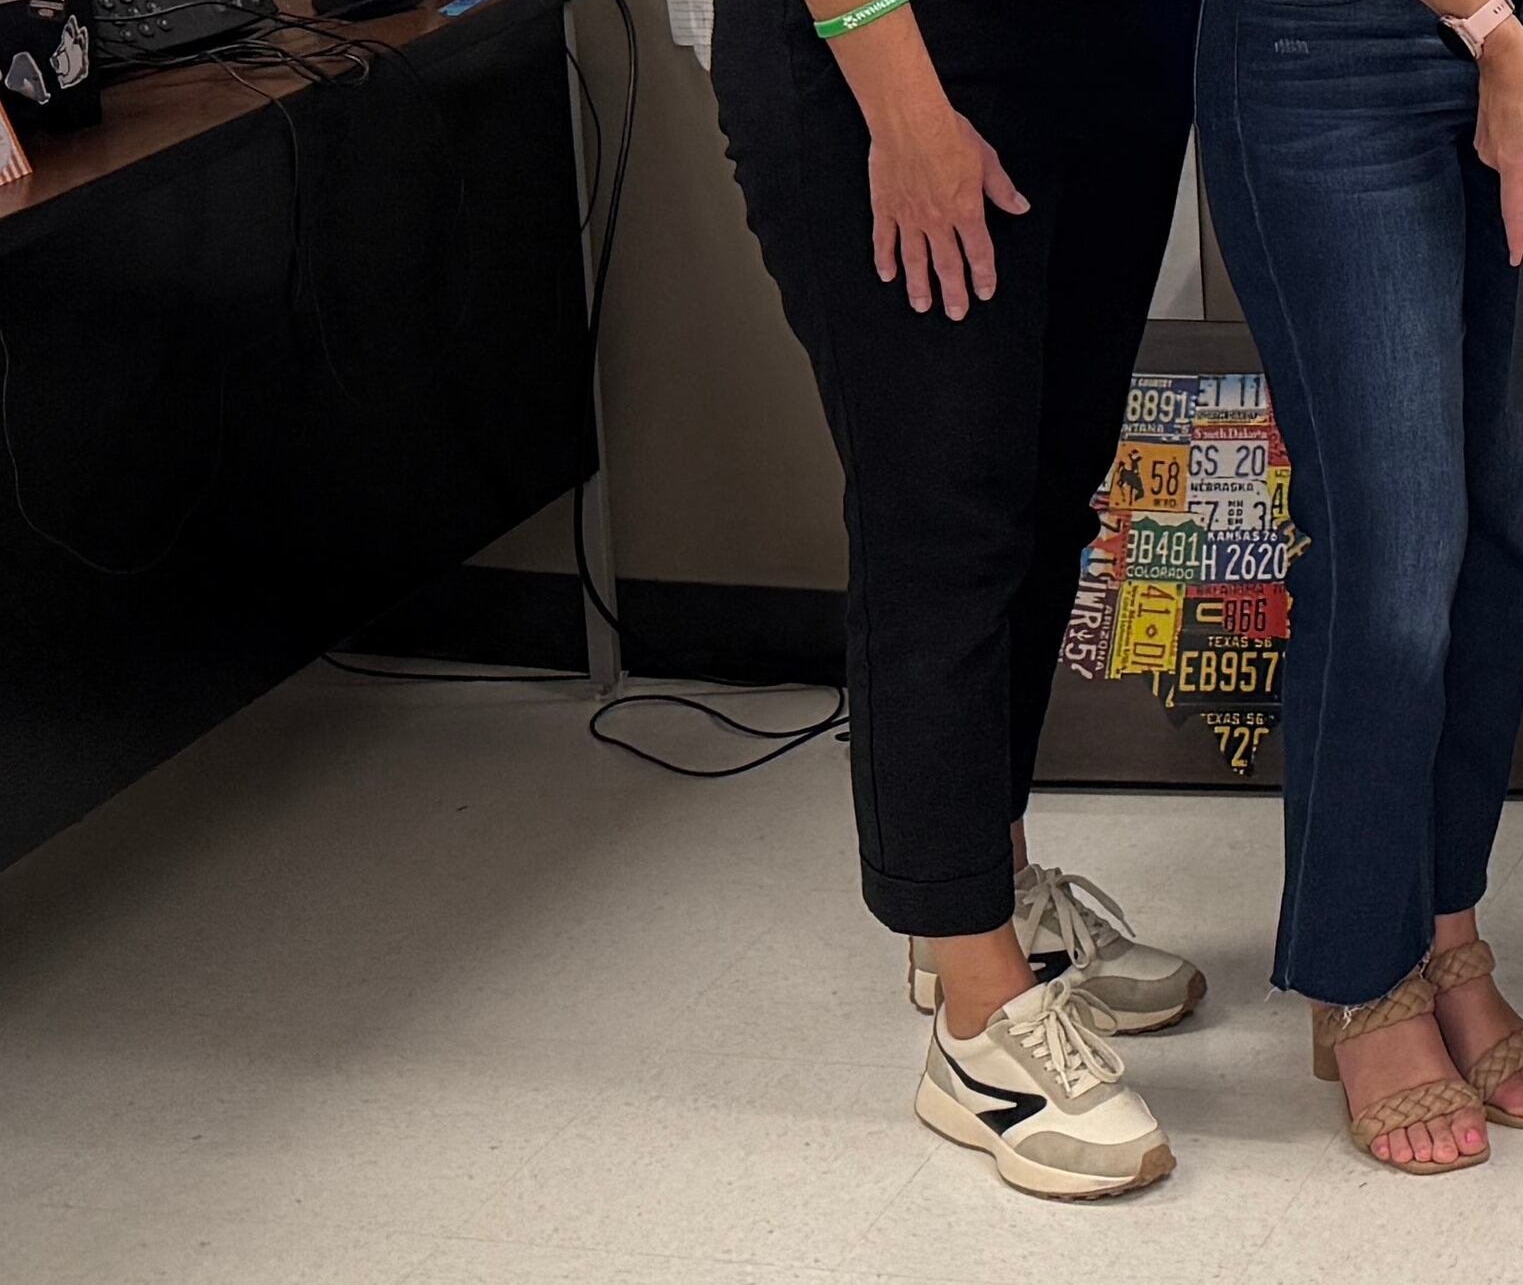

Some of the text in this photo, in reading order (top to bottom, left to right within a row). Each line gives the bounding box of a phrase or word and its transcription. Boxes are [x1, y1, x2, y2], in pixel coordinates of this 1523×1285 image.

[1227, 427, 1269, 440] Dakota
[1150, 459, 1181, 496] 58
[1235, 444, 1267, 477] 20
[1190, 480, 1255, 493] NEBRASKA
[1207, 529, 1261, 542] KANSAS
[1225, 543, 1288, 581] 2620
[1126, 565, 1195, 581] COLORADO
[1095, 604, 1114, 672] ARIZONA
[1207, 636, 1273, 649] TEXAS 56
[1178, 650, 1280, 693] EB957
